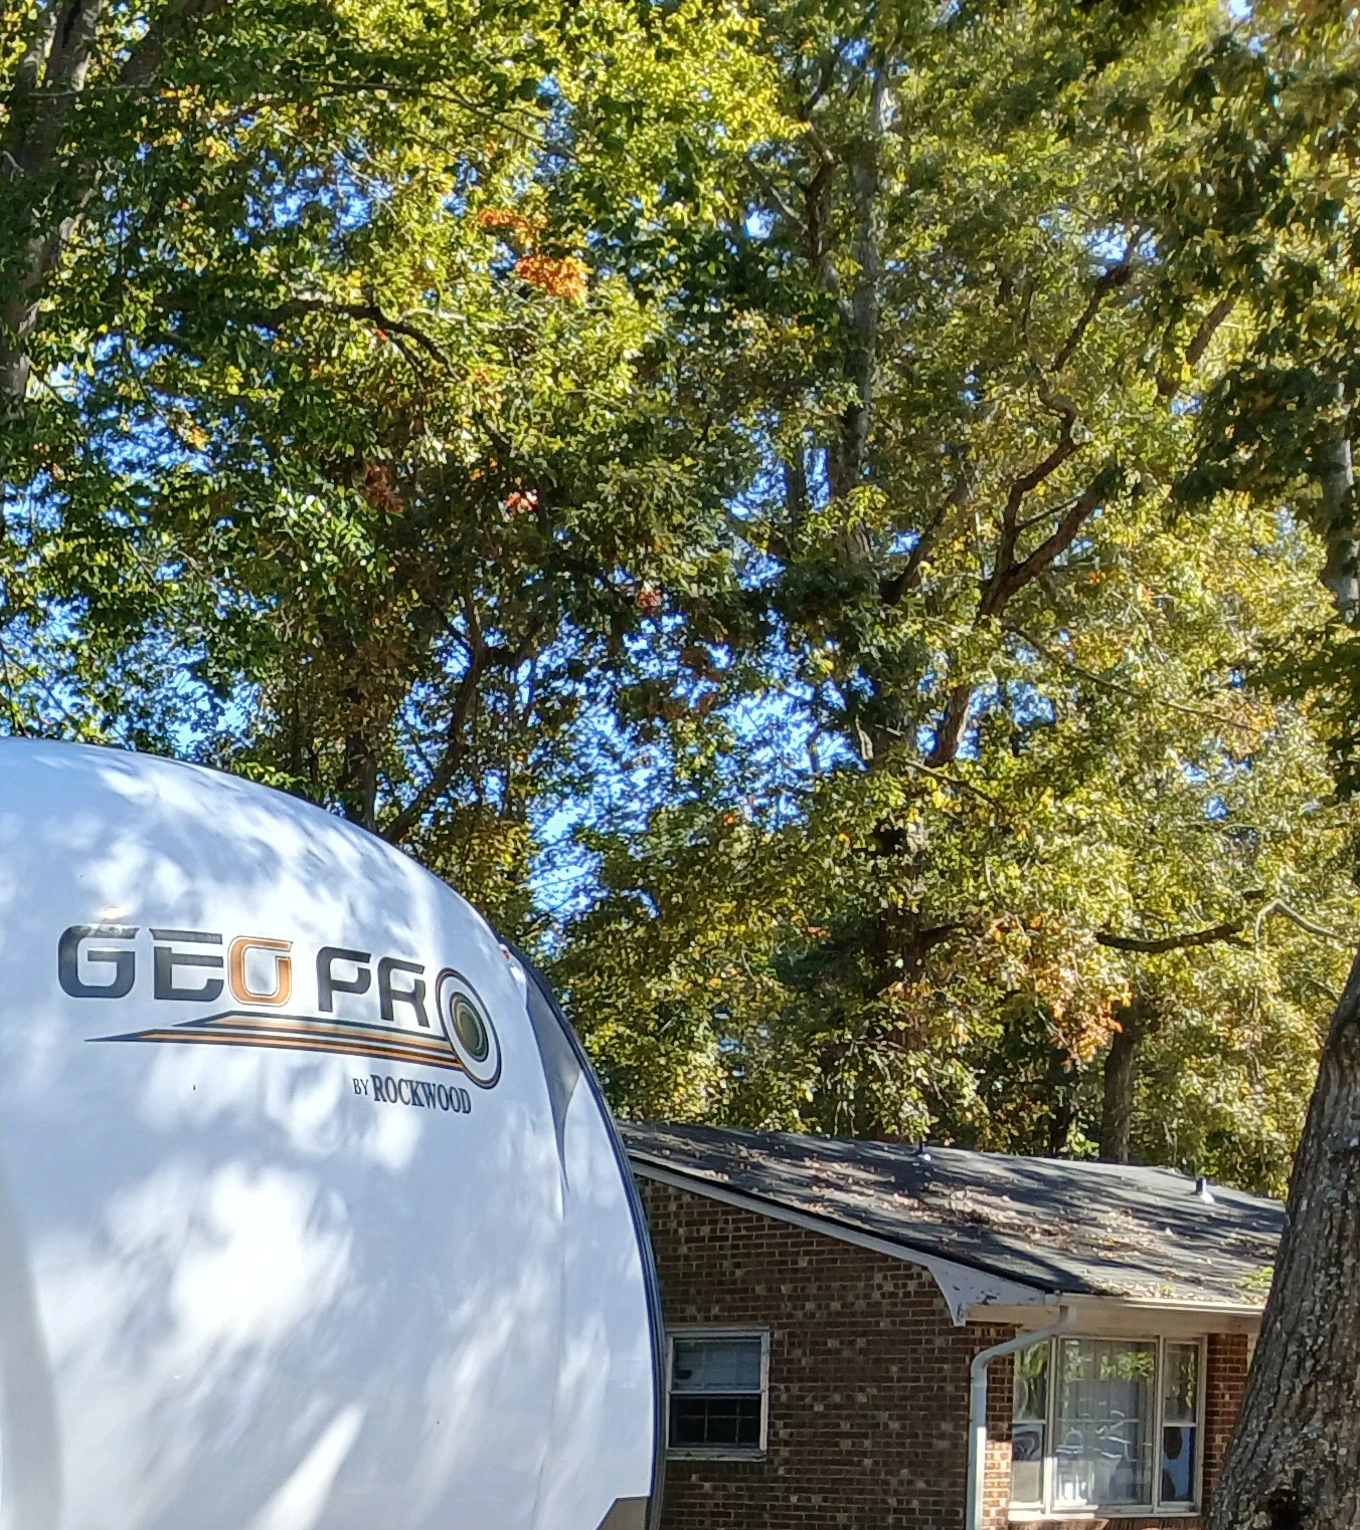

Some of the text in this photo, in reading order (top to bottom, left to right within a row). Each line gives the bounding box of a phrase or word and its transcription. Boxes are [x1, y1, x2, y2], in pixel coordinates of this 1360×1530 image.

[57, 924, 294, 1007] GEO
[352, 1074, 472, 1115] BY ROCKWOOD
